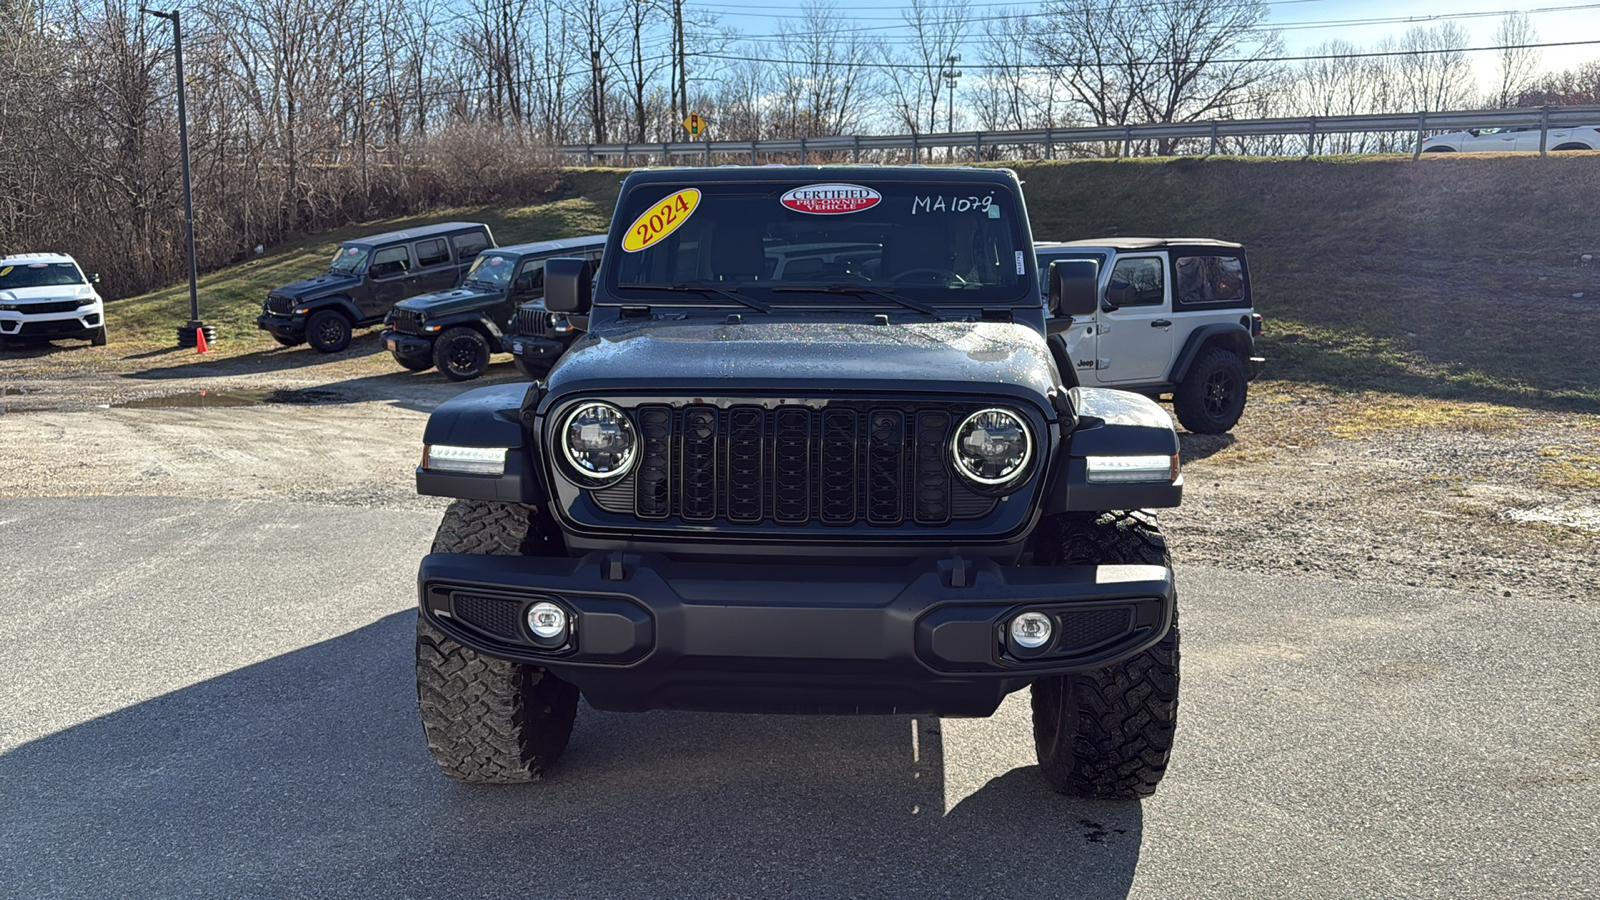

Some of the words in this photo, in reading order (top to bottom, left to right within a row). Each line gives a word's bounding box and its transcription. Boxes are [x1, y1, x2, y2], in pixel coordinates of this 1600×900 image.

[792, 189, 870, 200] CERTIFIED
[796, 198, 867, 206] PRE-OWNED
[806, 203, 857, 211] VEHICLE
[637, 194, 690, 246] 2024
[1077, 359, 1094, 368] Jeep
